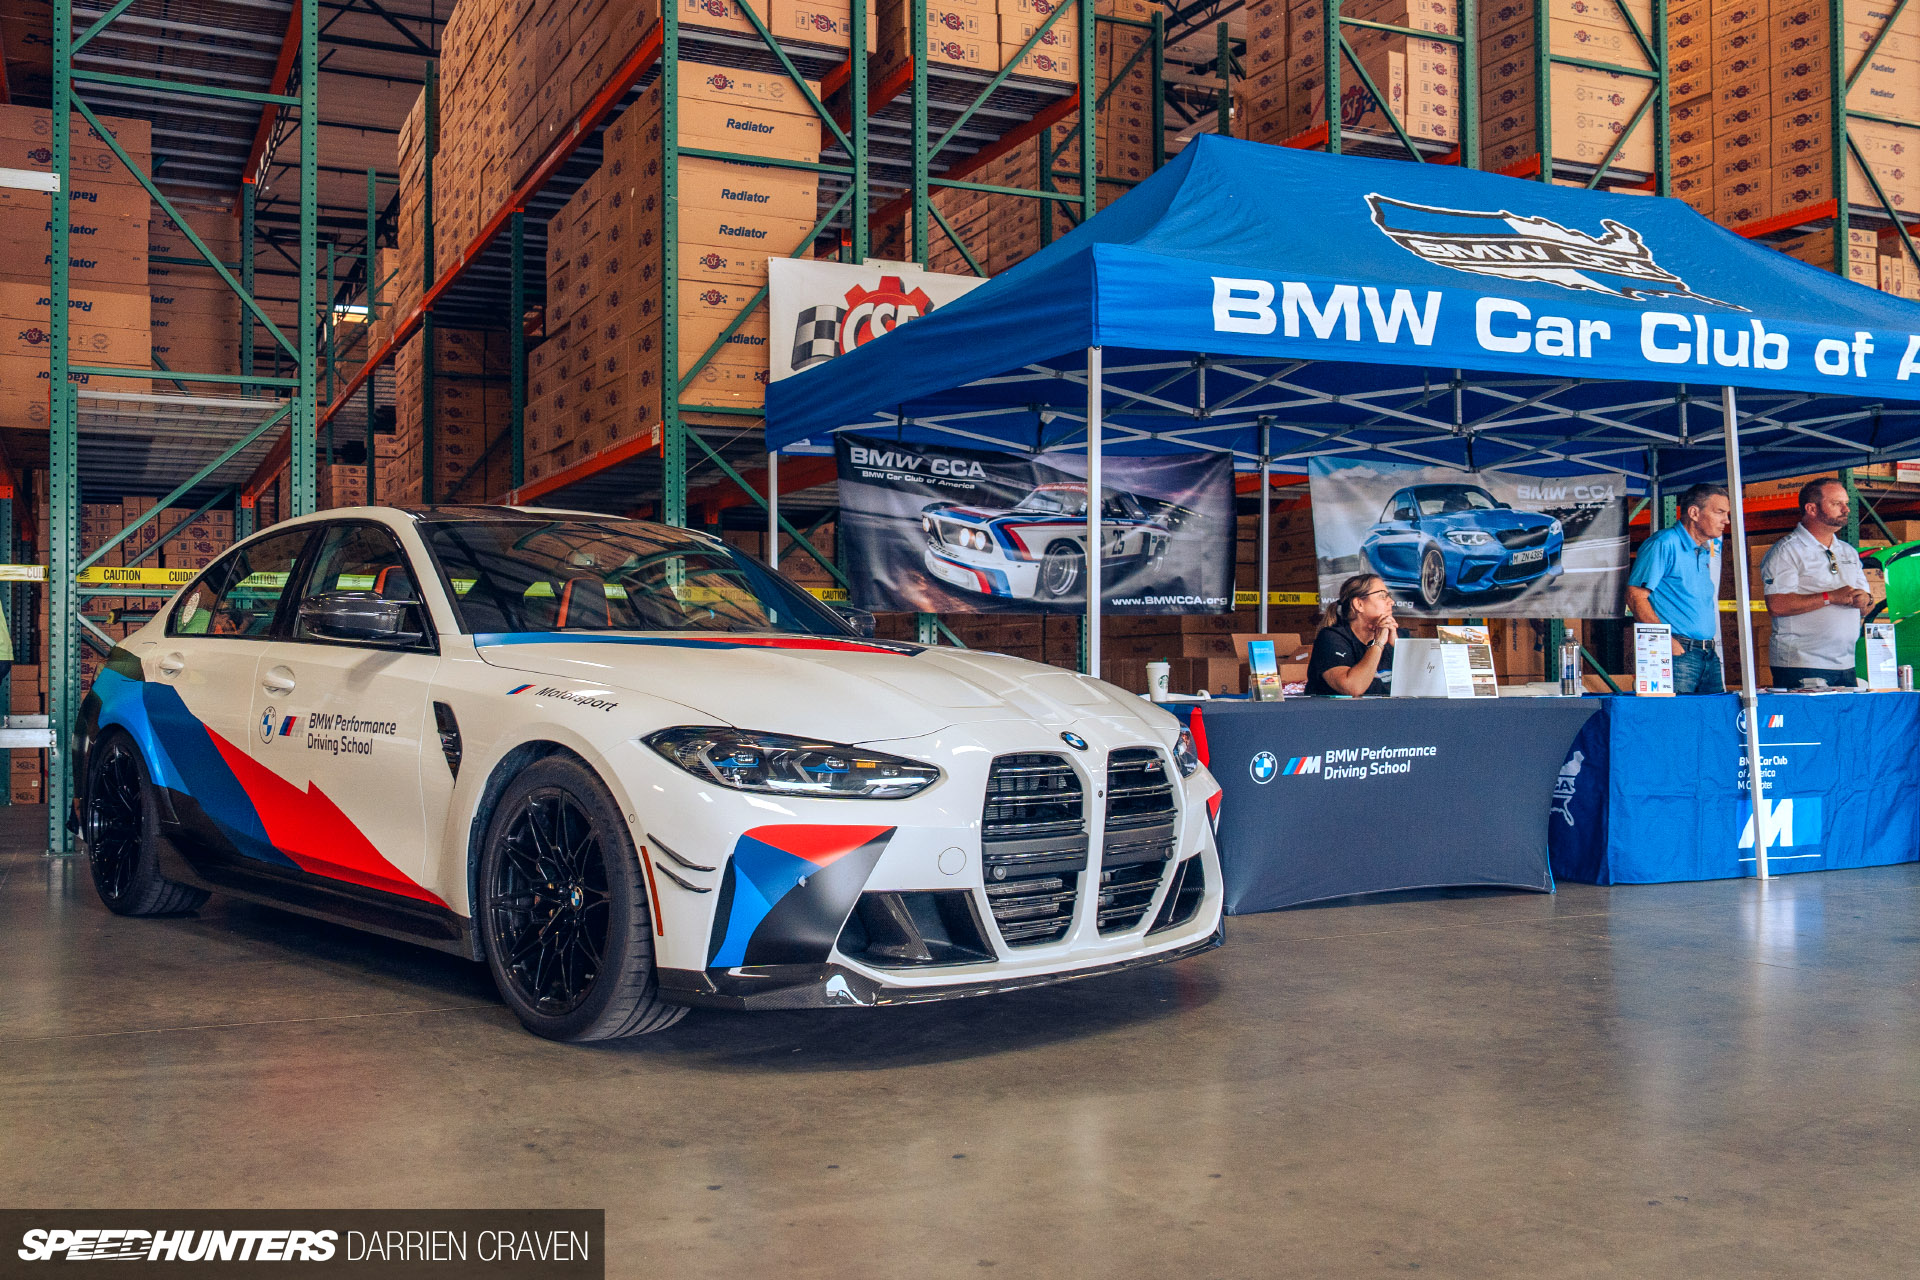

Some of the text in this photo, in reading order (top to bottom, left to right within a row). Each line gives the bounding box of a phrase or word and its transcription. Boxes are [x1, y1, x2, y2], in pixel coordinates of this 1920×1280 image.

[726, 118, 774, 134] Radiator
[721, 188, 770, 203] Radiator
[45, 221, 98, 236] Riator
[719, 224, 767, 239] Radiator
[44, 254, 98, 269] Riator
[36, 297, 93, 312] Rador
[1210, 276, 1443, 346] BMW
[1475, 297, 1611, 358] Car
[1640, 311, 1790, 371] Club
[1814, 331, 1875, 378] of
[850, 446, 987, 478] BMW CCA
[862, 470, 885, 480] BMW
[886, 473, 903, 481] Car
[904, 474, 925, 483] Club
[937, 479, 975, 490] America
[1517, 485, 1615, 500] BMW CCA
[1112, 529, 1125, 555] 25
[104, 569, 141, 581] CAUTION
[822, 590, 846, 600] CAUTION
[1112, 595, 1227, 606] www.BMWCCA.org
[1235, 594, 1257, 602] CUIDADO
[535, 687, 619, 712] Motorsport
[309, 712, 397, 735] BMW Performance
[307, 732, 373, 756] Driving School
[1326, 746, 1437, 763] BMW Performance
[1773, 755, 1788, 765] Club
[1324, 760, 1411, 780] Driving School
